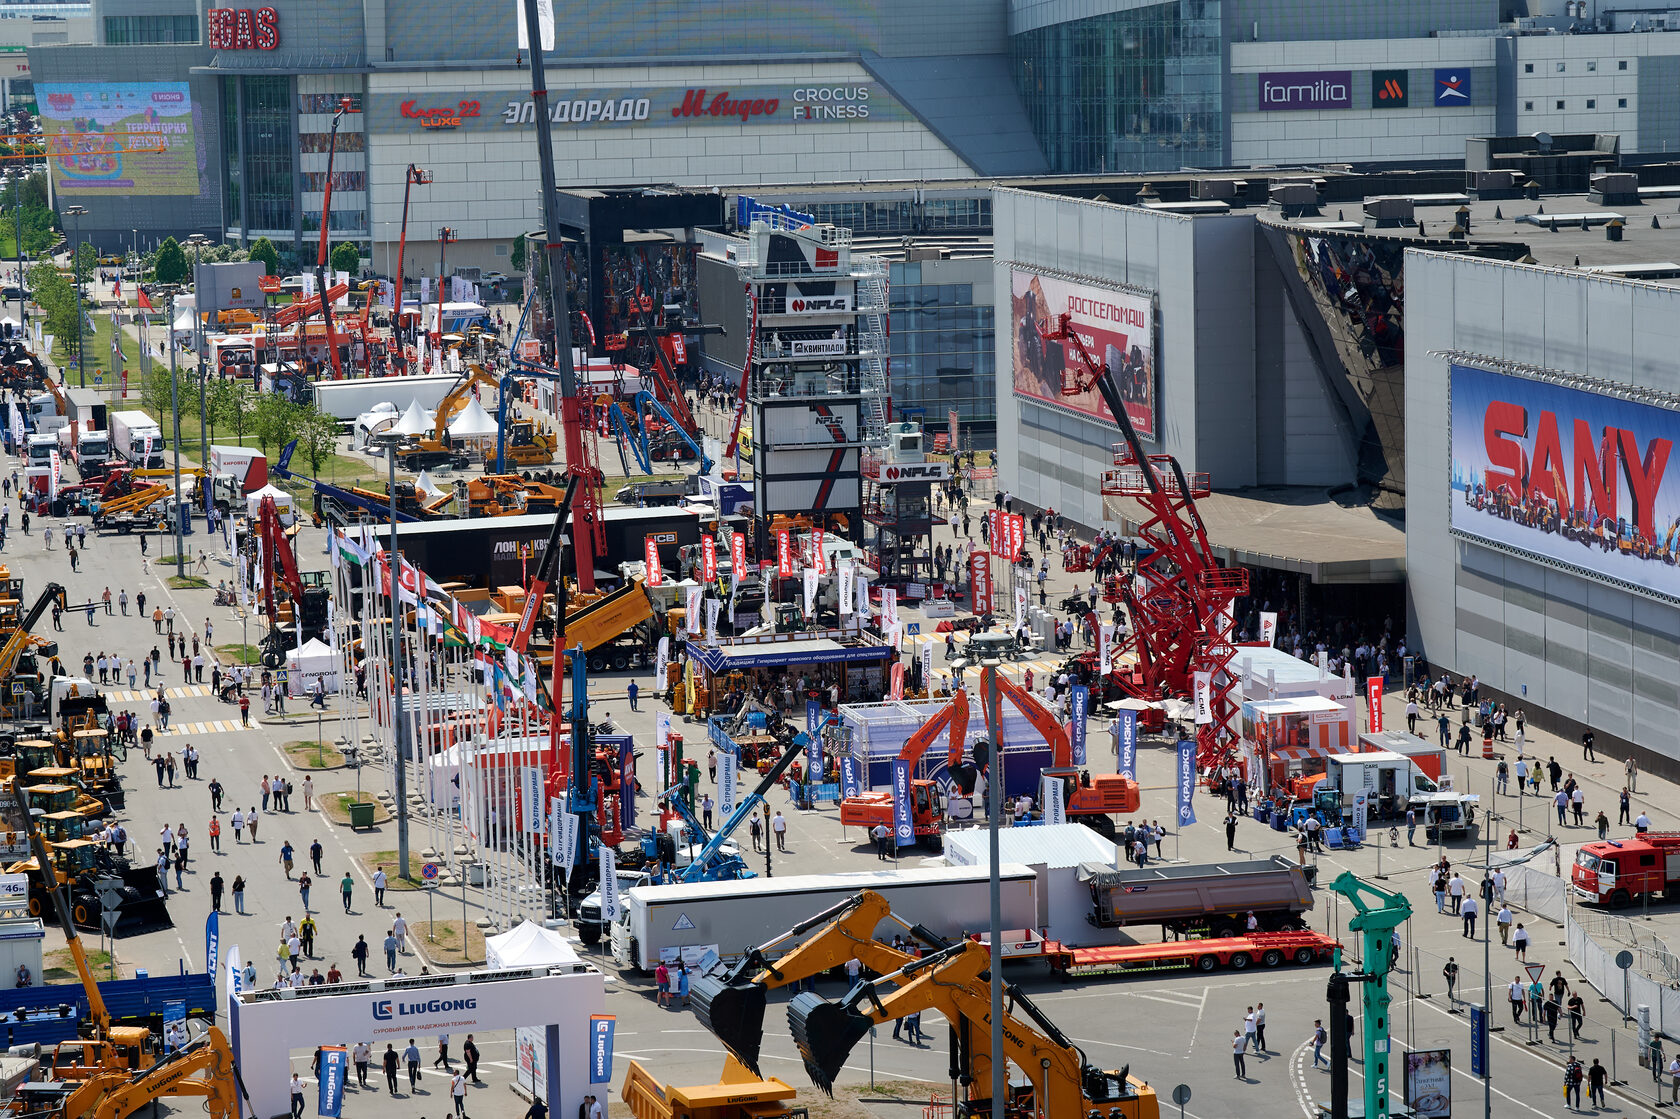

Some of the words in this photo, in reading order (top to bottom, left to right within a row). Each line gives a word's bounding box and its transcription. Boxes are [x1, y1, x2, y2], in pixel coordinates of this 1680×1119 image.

[792, 87, 869, 102] CROCUS
[1264, 79, 1347, 103] familia
[458, 100, 481, 118] 22
[671, 88, 779, 122] М.видео
[421, 117, 464, 127] LUXE
[806, 299, 846, 311] NFLG
[1068, 295, 1145, 329] РОСТСЕЛЬМАШ
[815, 416, 844, 425] NFLG
[900, 465, 942, 478] NFLG
[1484, 400, 1674, 546] SANY
[493, 540, 517, 554] ЛОН
[975, 570, 988, 612] NFLG
[1007, 690, 1040, 721] КРАНЭКС
[1075, 691, 1084, 742] КРАНЭКС
[1123, 716, 1132, 767] КРАНЭКС
[897, 766, 907, 821] КРАНЭКС
[373, 1025, 402, 1035] СУРОВЫЙ
[450, 1019, 477, 1027] ТЕХНИКА
